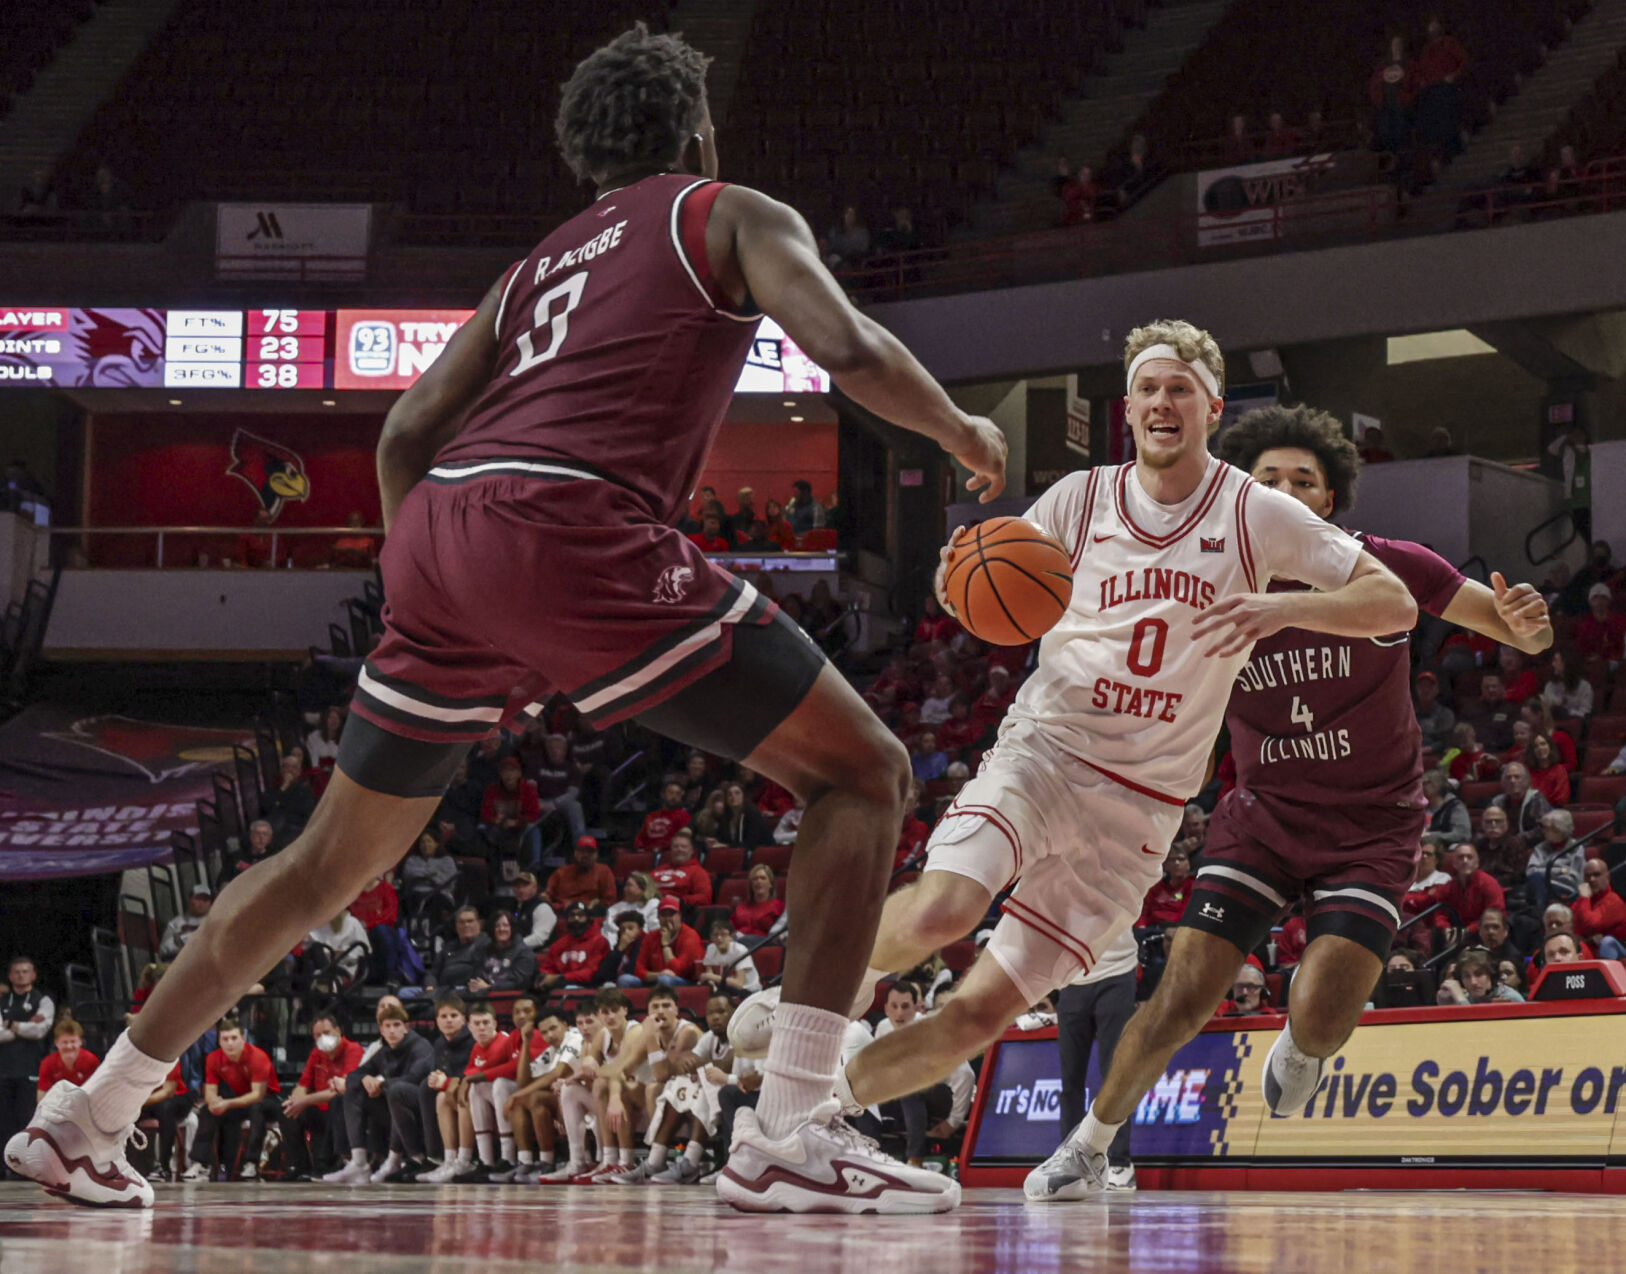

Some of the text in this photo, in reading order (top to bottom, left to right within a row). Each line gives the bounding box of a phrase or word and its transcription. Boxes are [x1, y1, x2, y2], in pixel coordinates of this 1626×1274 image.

[0, 312, 63, 326] AYER
[262, 309, 299, 333] 75
[399, 322, 458, 342] TRY
[509, 271, 589, 377] 0
[259, 336, 299, 360] 23
[357, 328, 390, 352] 93
[257, 363, 298, 388] 38
[1098, 568, 1216, 612] ILLINOIS
[1126, 617, 1169, 677] 0
[1236, 646, 1351, 692] SOUTHERN
[1092, 677, 1183, 723] STATE
[1290, 696, 1314, 732] 4
[1260, 729, 1351, 764] ILLINOIS
[1565, 975, 1586, 990] POSS
[995, 1084, 1030, 1114] IT'S
[1136, 1069, 1208, 1124] ME
[1270, 1055, 1626, 1119] rive Sober or
